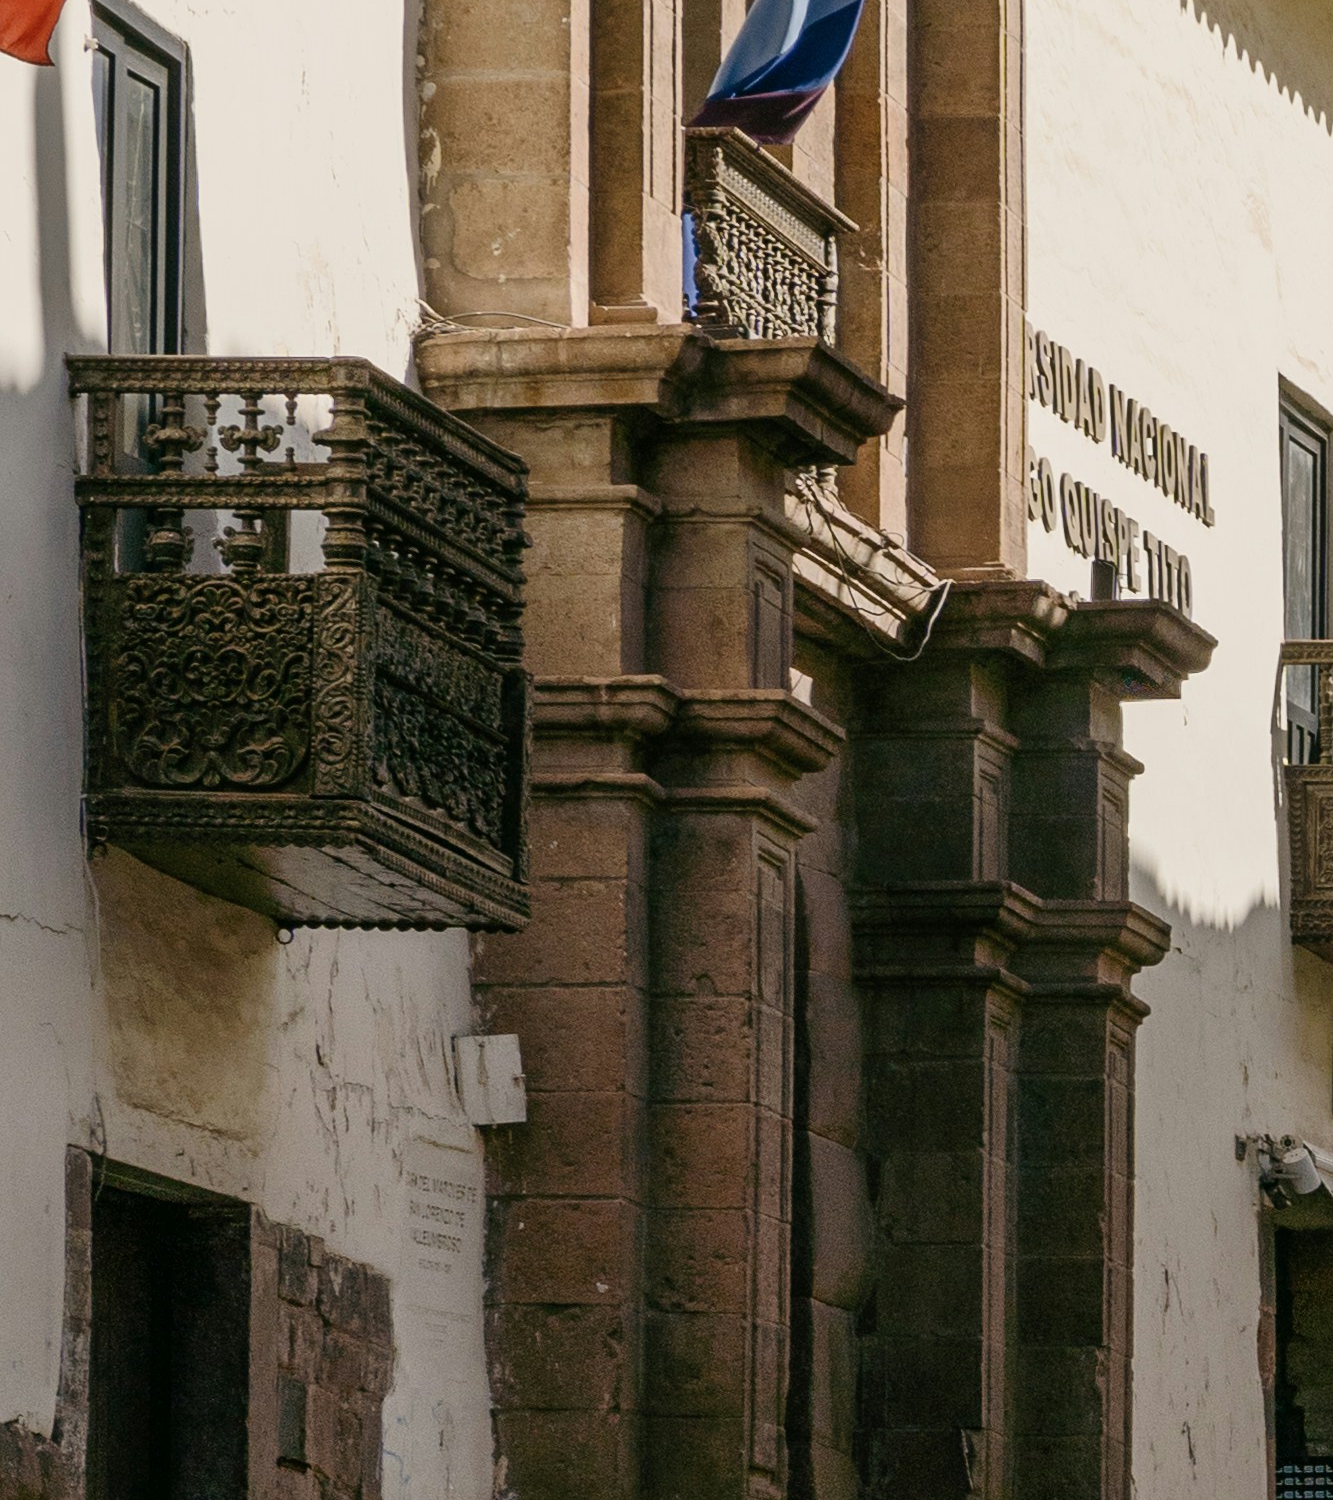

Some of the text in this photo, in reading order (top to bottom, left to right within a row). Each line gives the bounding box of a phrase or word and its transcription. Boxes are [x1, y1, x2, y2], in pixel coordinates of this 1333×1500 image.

[1109, 383, 1215, 528] NACIONAL
[1060, 472, 1141, 594] QUISPE
[1143, 530, 1193, 622] TITO
